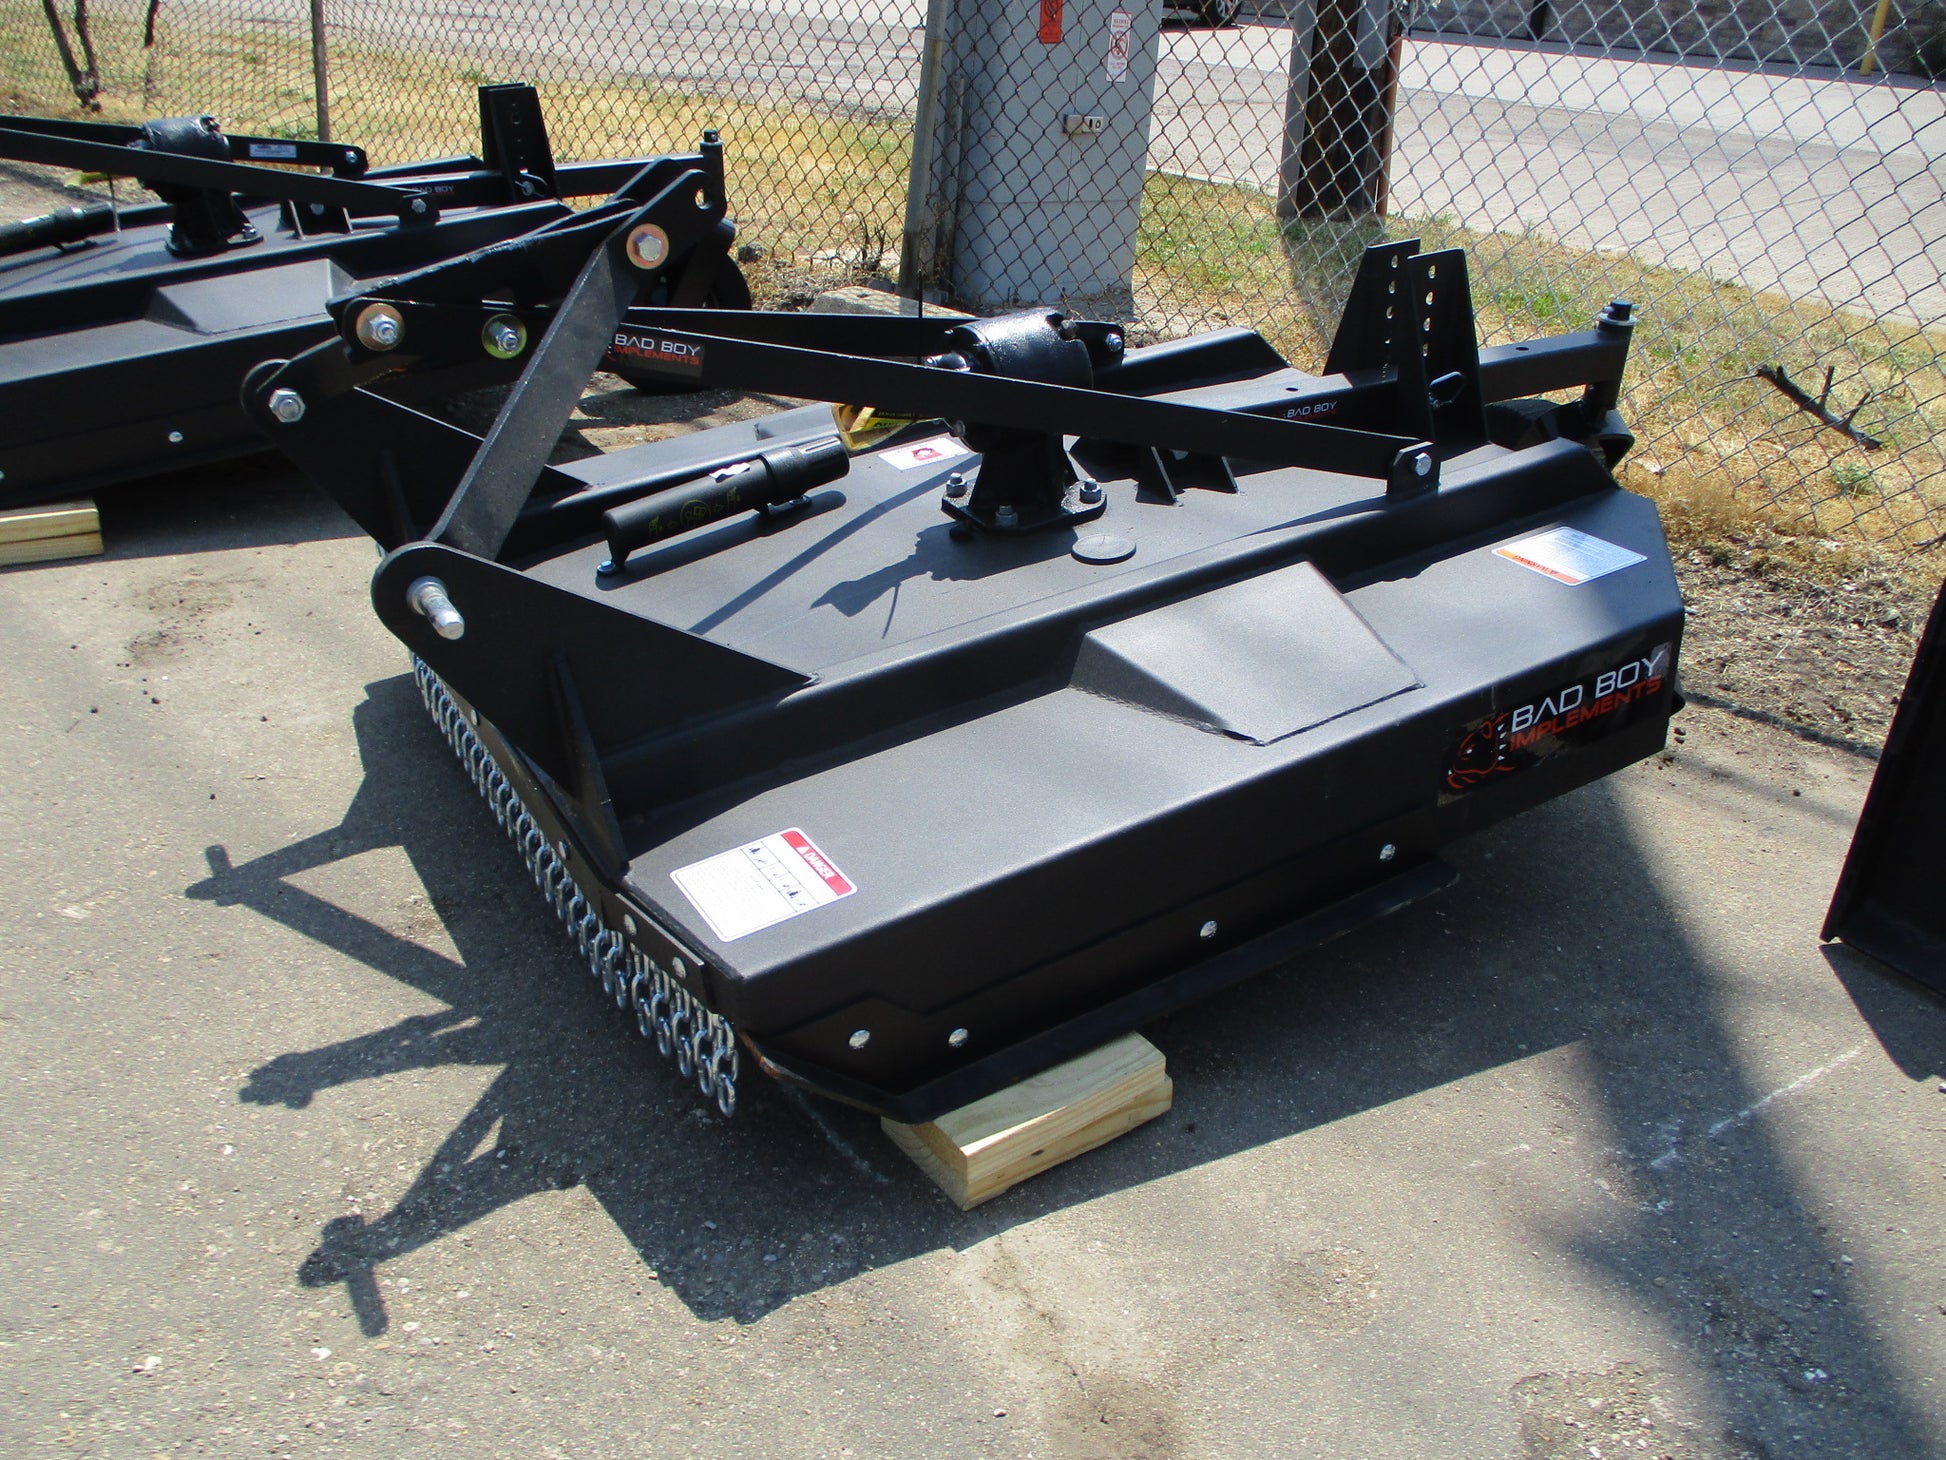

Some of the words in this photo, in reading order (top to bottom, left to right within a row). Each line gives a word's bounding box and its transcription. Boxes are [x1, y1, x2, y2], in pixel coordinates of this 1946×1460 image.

[613, 344, 700, 365] IMPLEMENTS
[615, 333, 655, 350] BAD
[661, 341, 701, 356] BOY
[1287, 406, 1311, 418] BAD
[1314, 401, 1337, 413] BOY
[1511, 684, 1583, 733] BAD
[1595, 650, 1665, 699] BOY
[1510, 674, 1664, 752] IMPLEMENTS
[803, 852, 835, 880] DANGER
